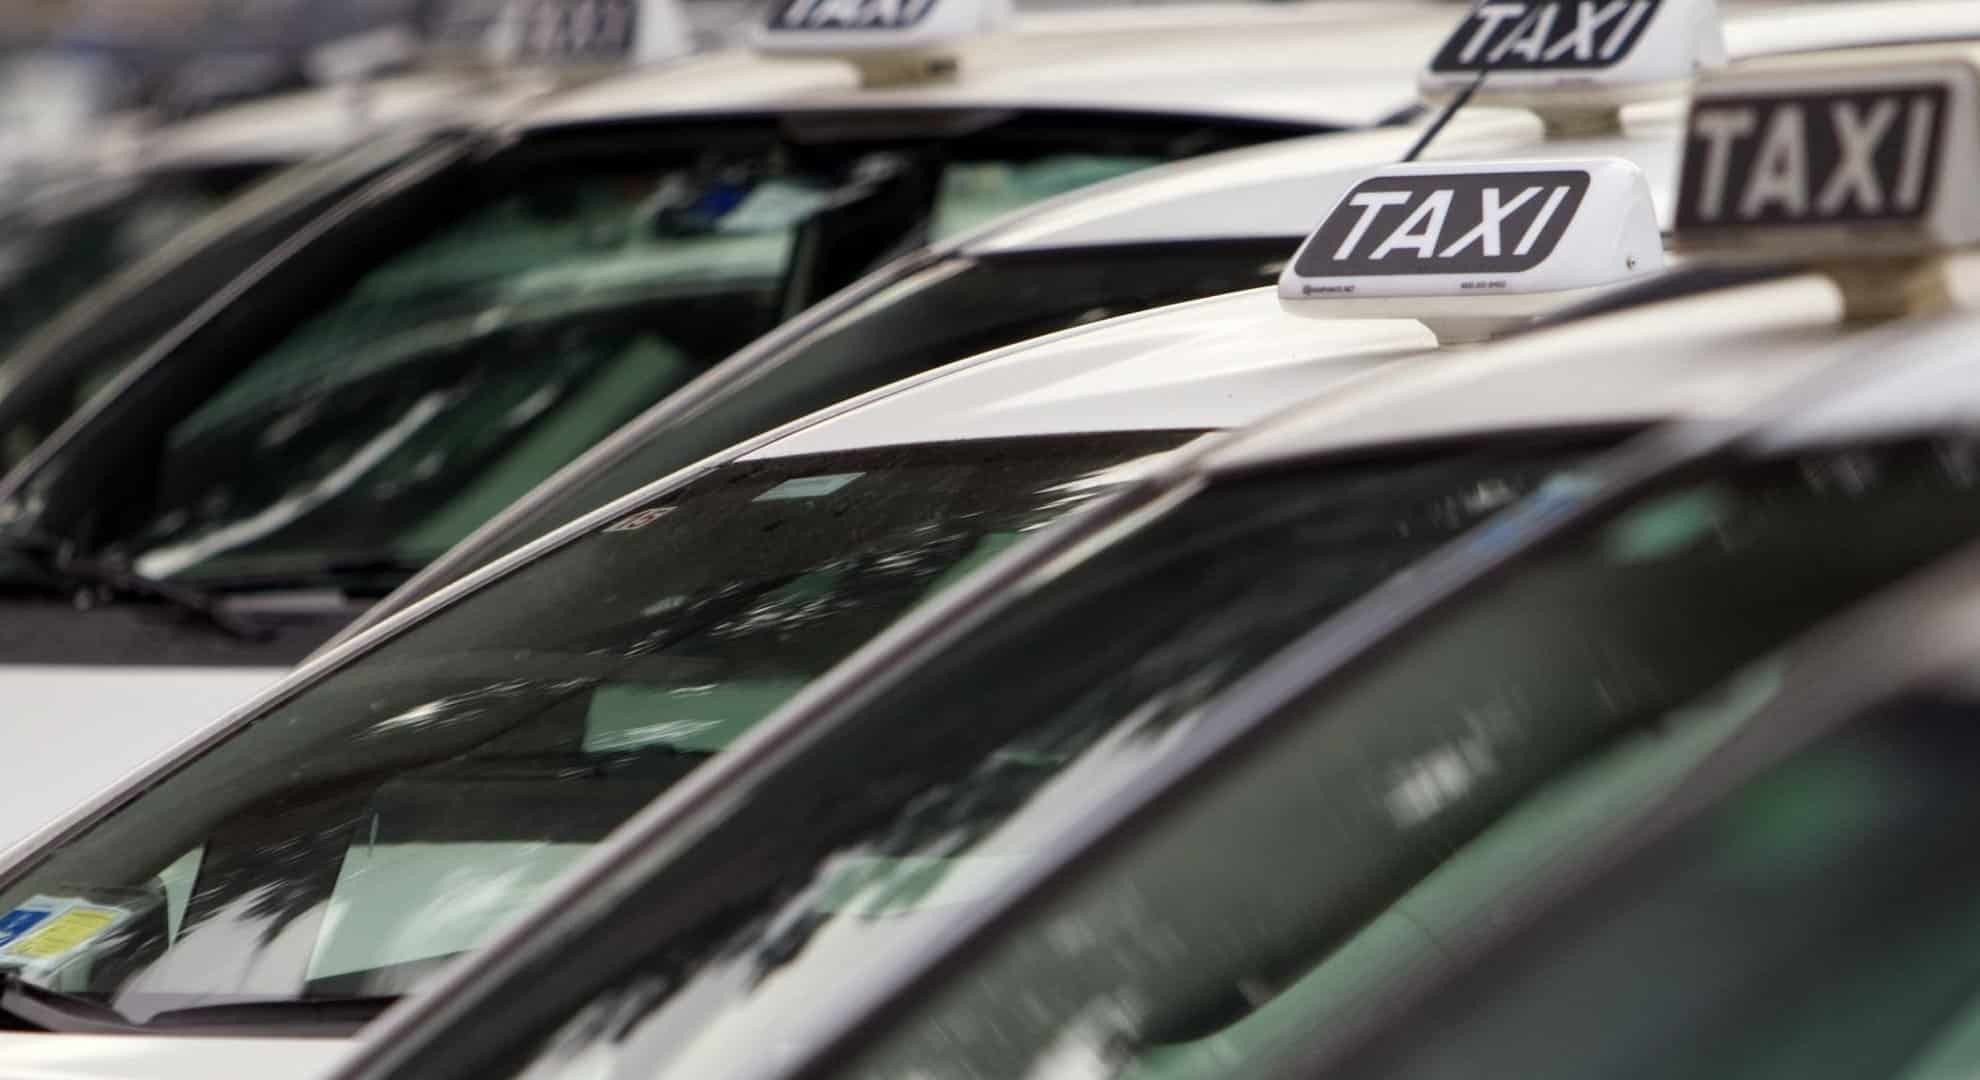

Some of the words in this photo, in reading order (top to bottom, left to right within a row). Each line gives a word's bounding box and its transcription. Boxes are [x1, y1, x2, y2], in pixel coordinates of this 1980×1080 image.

[1457, 0, 1651, 63] TAXI
[1693, 99, 1936, 218] TAXI
[1332, 185, 1571, 261] TAXI
